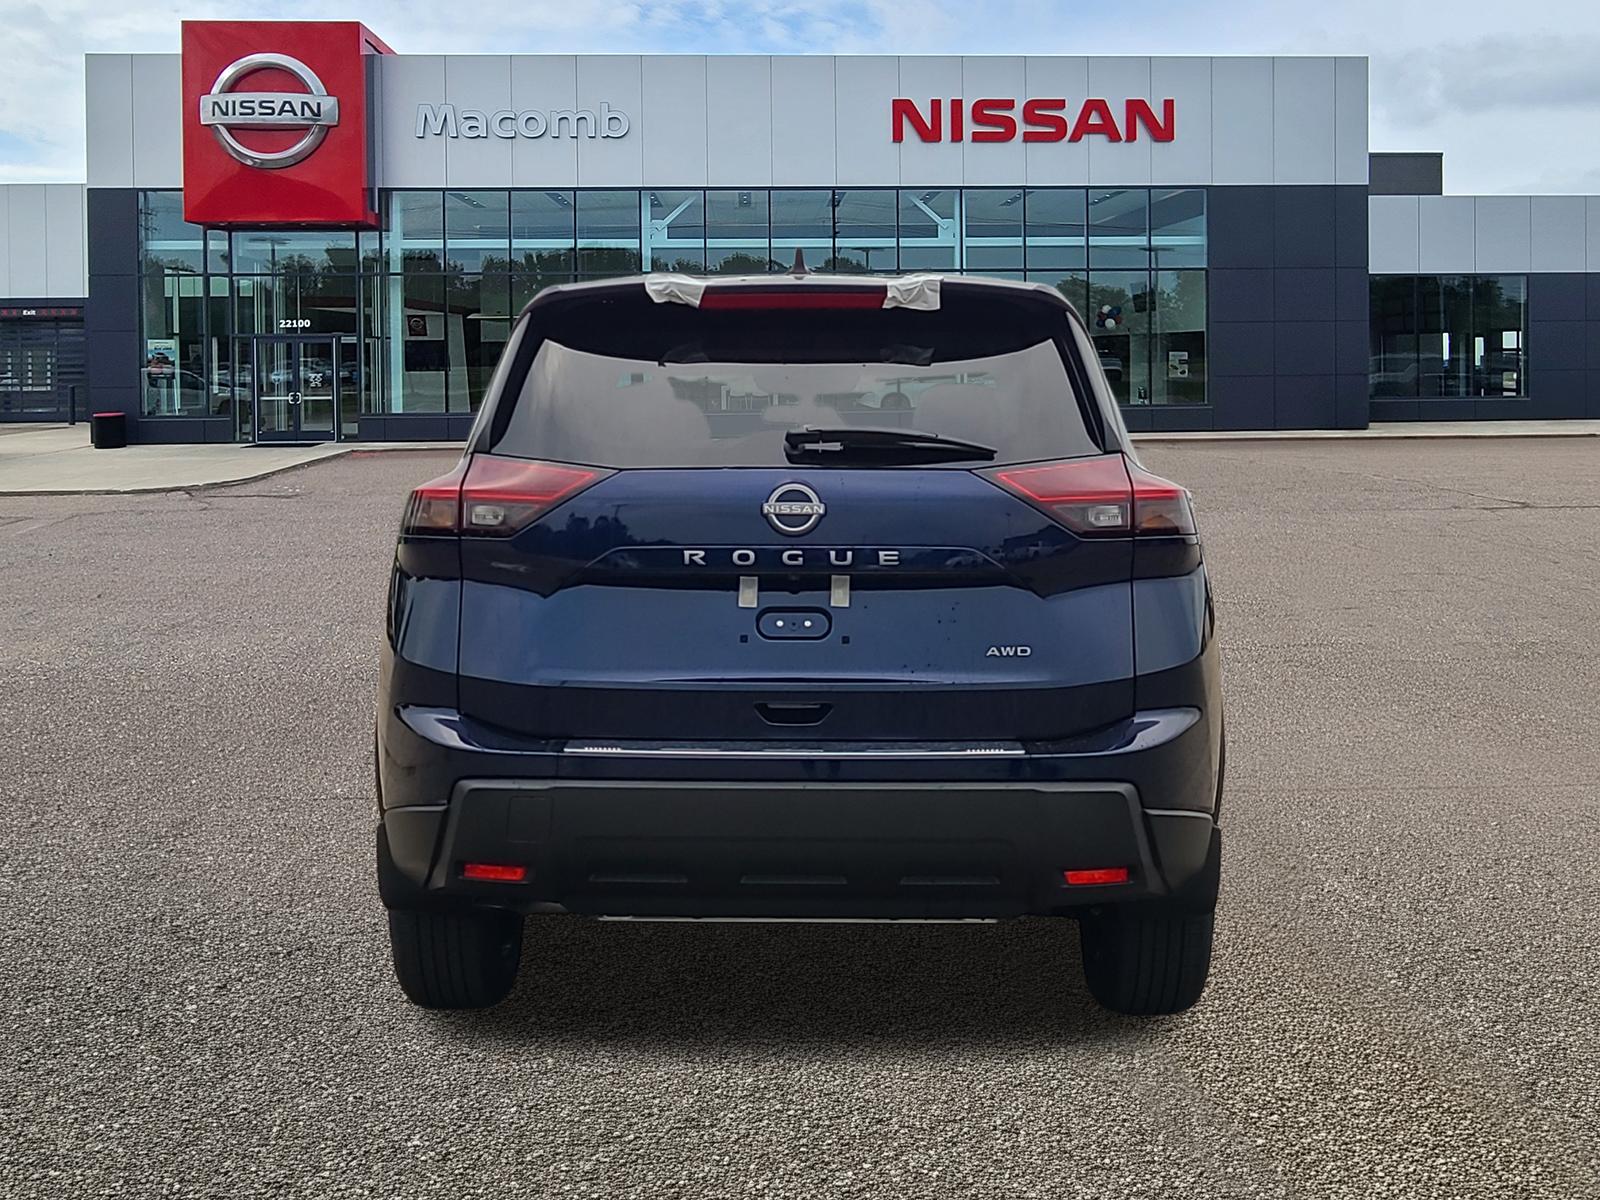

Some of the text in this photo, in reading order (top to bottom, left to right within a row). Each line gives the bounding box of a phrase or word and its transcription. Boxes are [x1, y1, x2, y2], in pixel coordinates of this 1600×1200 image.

[212, 100, 322, 117] NISSAN
[415, 102, 630, 138] Macomb
[892, 98, 1176, 143] NISSAN
[279, 319, 311, 328] 22100
[764, 505, 824, 514] NISSAN
[683, 550, 901, 566] ROGUE
[985, 646, 1032, 657] AWD
